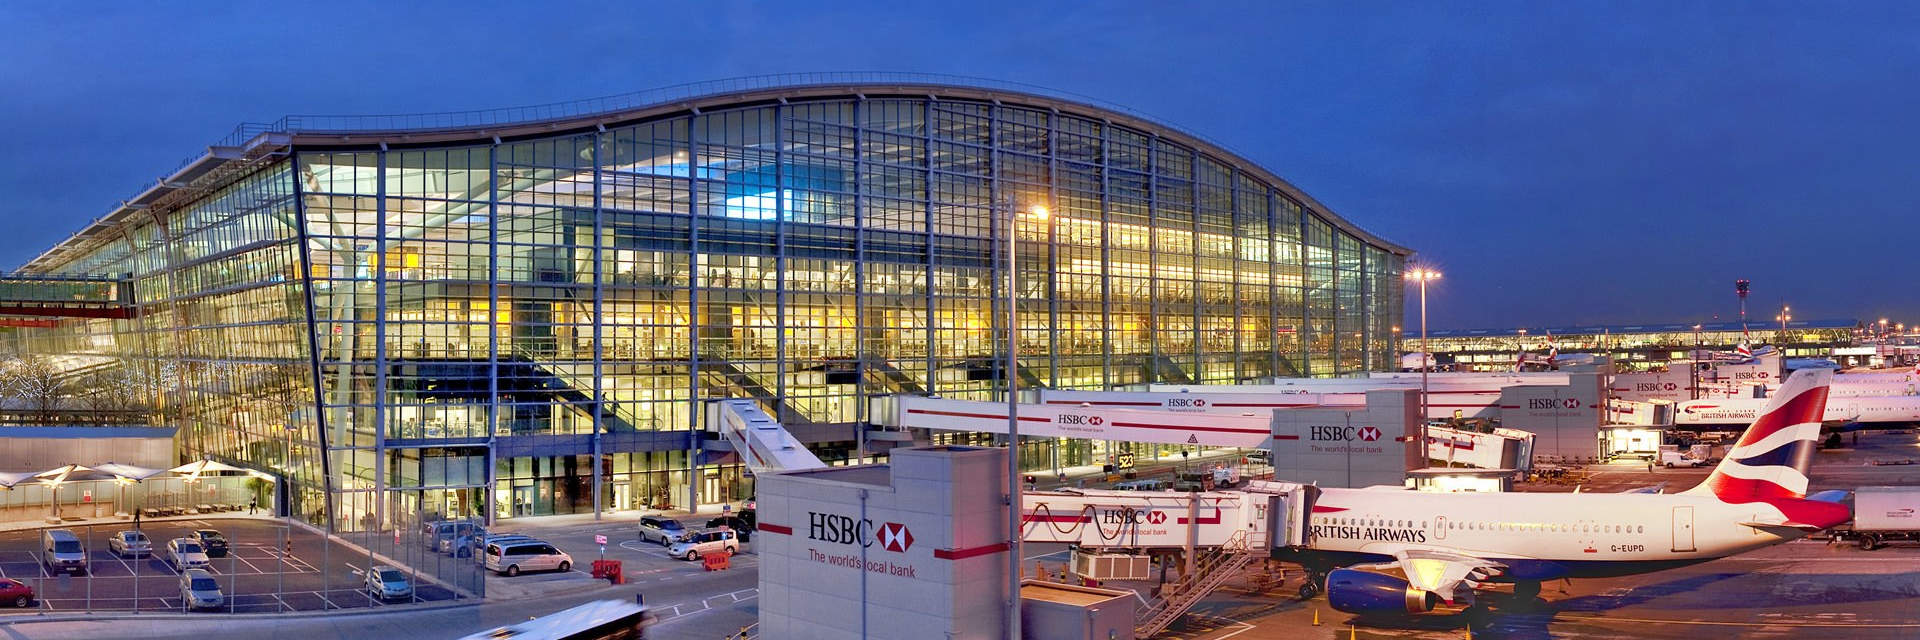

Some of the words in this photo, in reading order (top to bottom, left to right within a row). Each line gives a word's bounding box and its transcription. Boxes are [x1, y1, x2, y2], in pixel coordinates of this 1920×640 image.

[1736, 372, 1757, 380] HSBC
[1637, 383, 1663, 391] HSBC
[1168, 398, 1193, 407] HSBC
[1529, 398, 1562, 409] HSBC
[1058, 414, 1088, 425] HSBC
[1310, 426, 1355, 441] HSBC
[1119, 455, 1133, 468] 523
[1103, 509, 1144, 524] HSBC
[808, 511, 873, 548] HSBC
[1363, 528, 1426, 543] AIRWAYS
[809, 548, 825, 563] The
[828, 555, 861, 569] world's
[864, 558, 887, 573] local
[890, 562, 915, 578] bank
